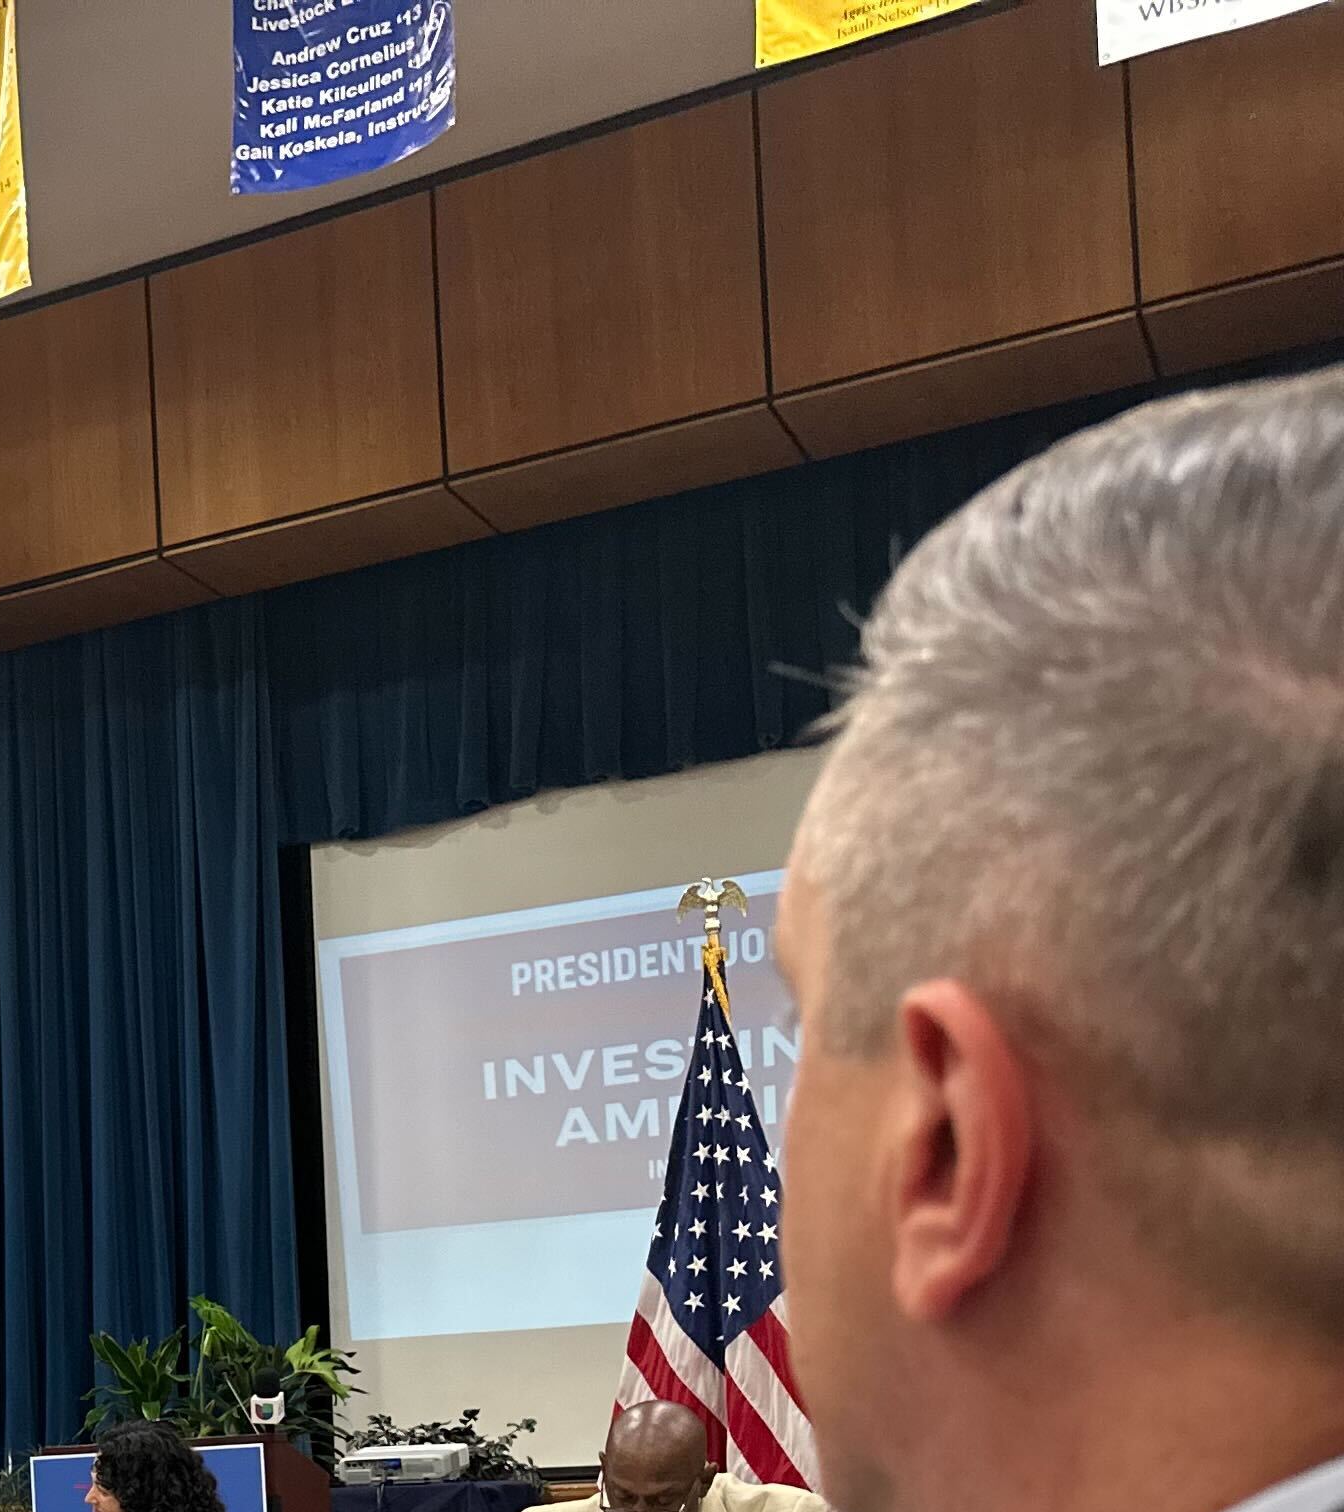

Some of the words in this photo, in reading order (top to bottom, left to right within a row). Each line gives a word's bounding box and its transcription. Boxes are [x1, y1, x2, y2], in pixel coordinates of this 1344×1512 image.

[252, 1, 336, 32] Livestock
[247, 71, 321, 94] Jessica
[326, 36, 415, 80] Cornelius
[272, 35, 341, 66] Andrew
[346, 21, 392, 45] Cruz
[262, 97, 313, 117] Katie
[319, 67, 403, 106] Kilcullen
[303, 88, 404, 131] McFarland
[235, 144, 272, 161] Gail
[279, 130, 362, 160] Koskela,
[511, 936, 703, 997] PRESIDENT
